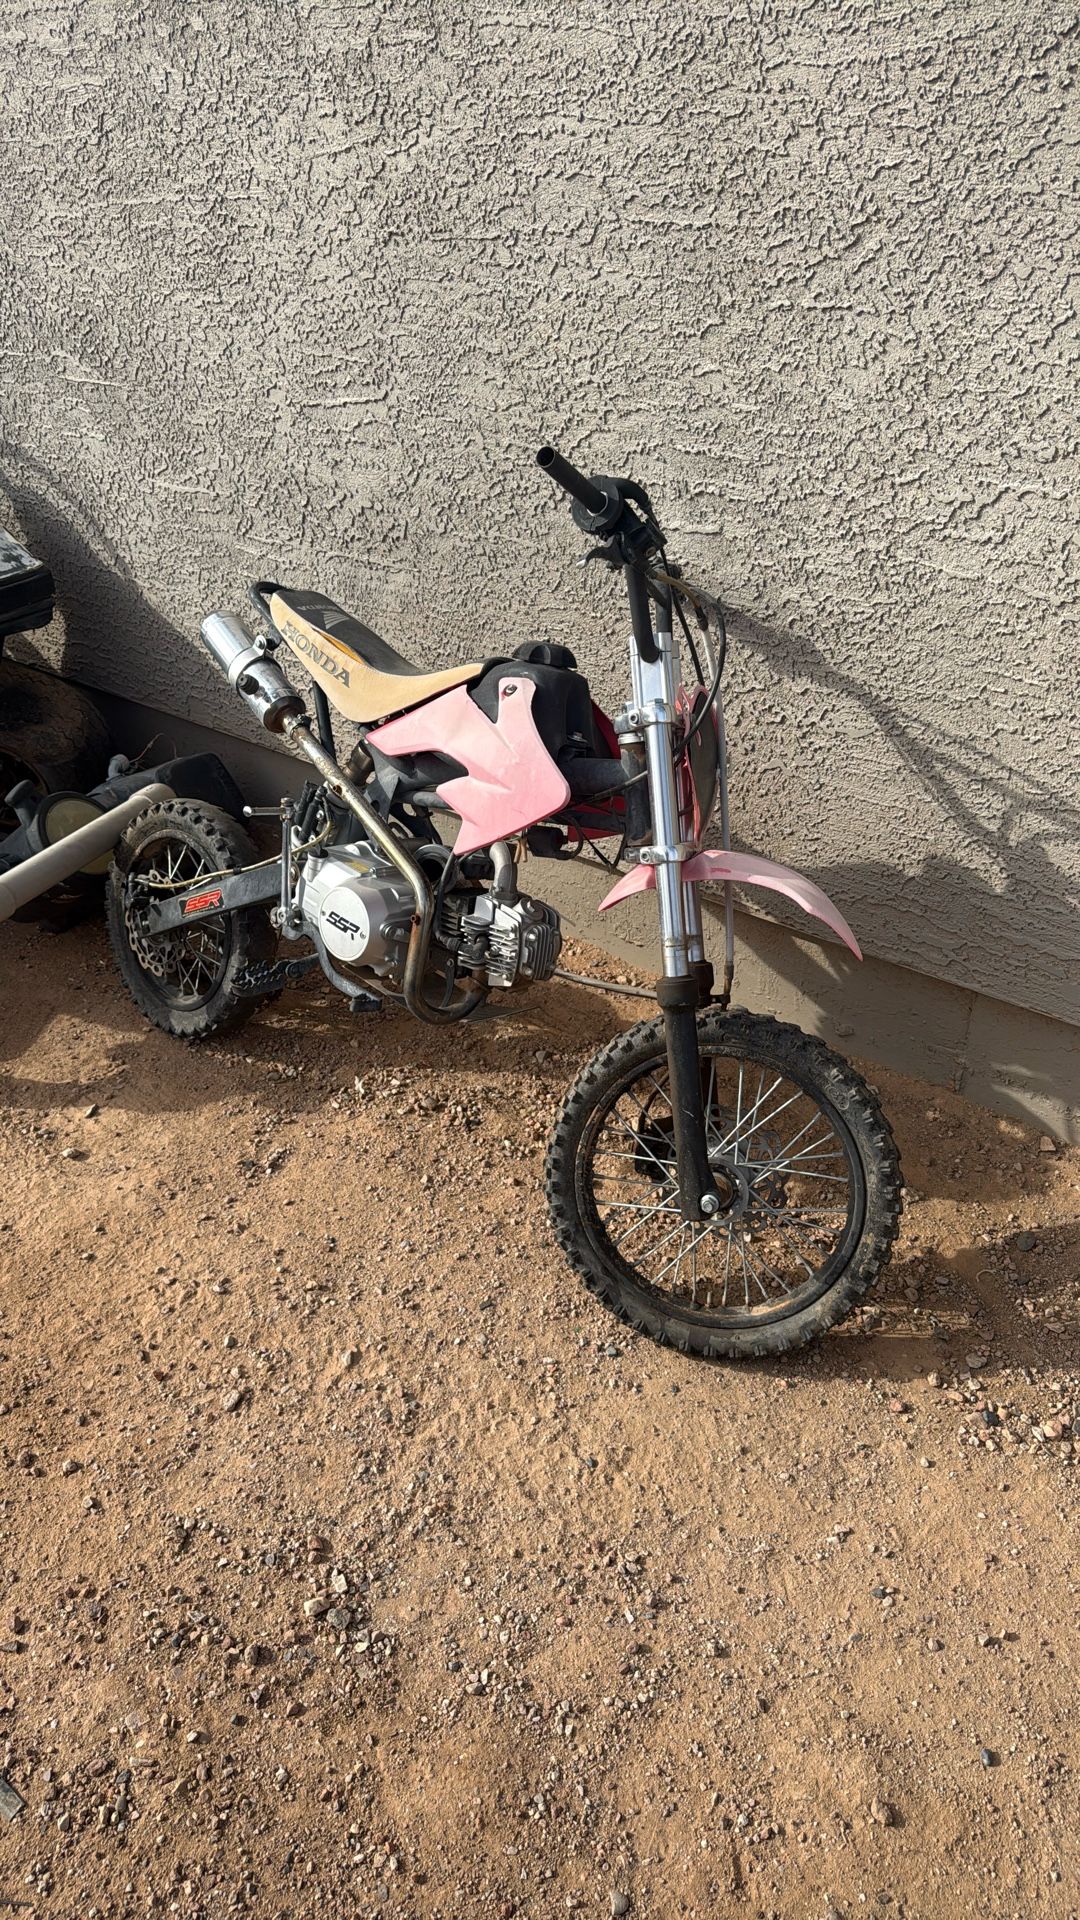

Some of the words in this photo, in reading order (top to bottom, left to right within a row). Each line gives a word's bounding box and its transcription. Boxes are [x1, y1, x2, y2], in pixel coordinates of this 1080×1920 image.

[281, 620, 350, 688] HONDA
[185, 889, 221, 913] SSR
[326, 911, 360, 940] SSR
